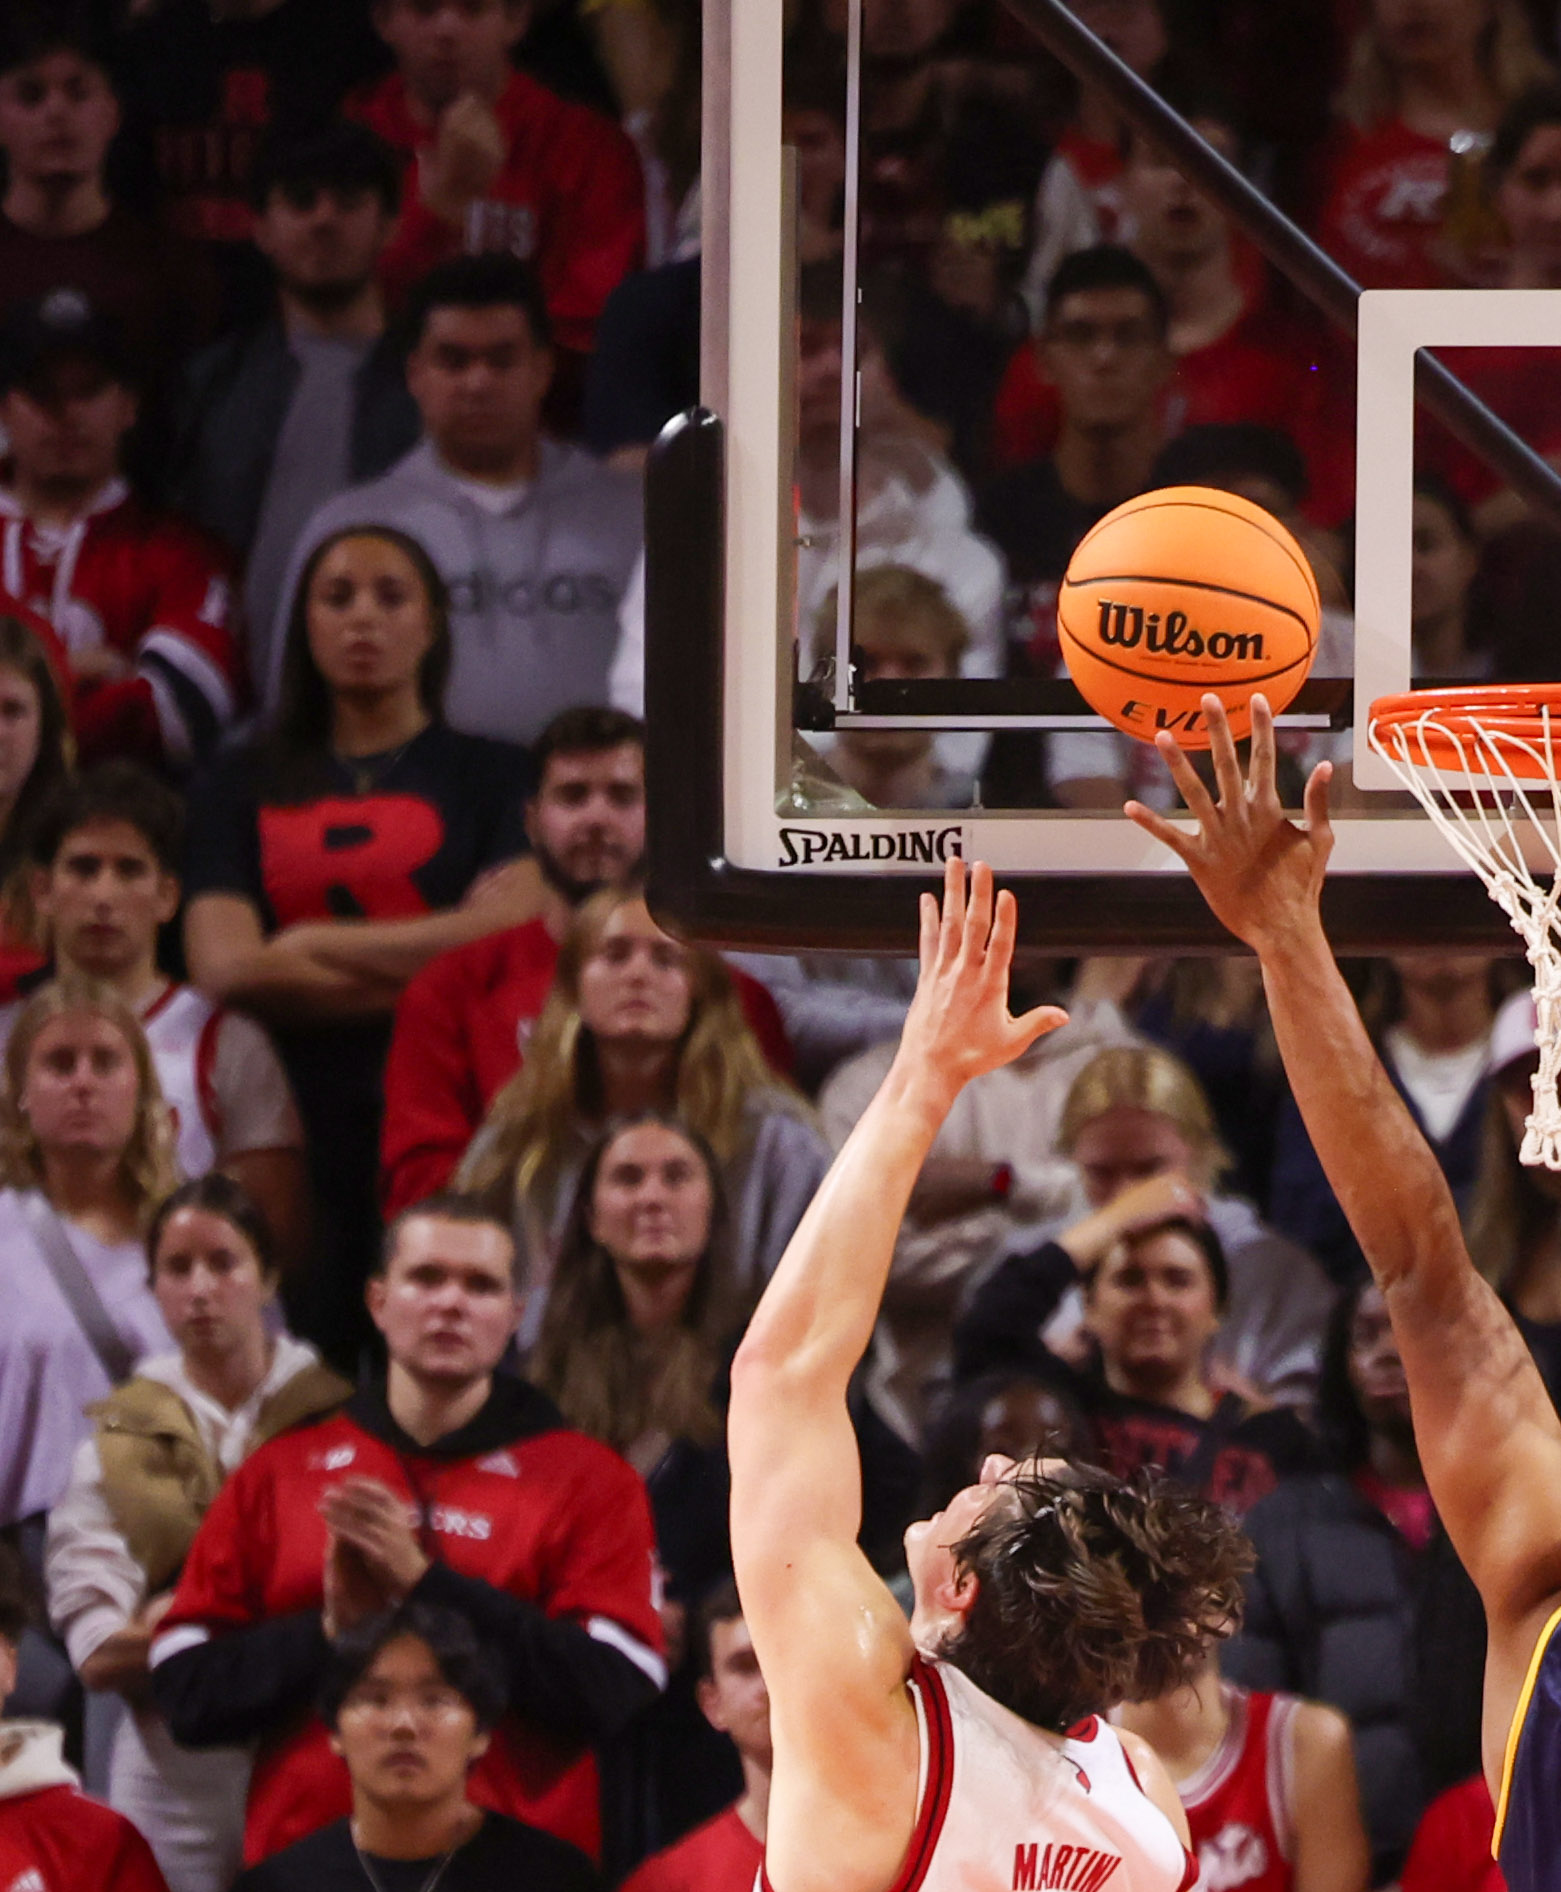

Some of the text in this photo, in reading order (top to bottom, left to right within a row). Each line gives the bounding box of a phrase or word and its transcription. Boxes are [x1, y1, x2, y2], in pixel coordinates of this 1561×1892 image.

[1098, 600, 1263, 661] Wilson
[257, 792, 446, 926] R
[779, 826, 962, 868] SPALDING
